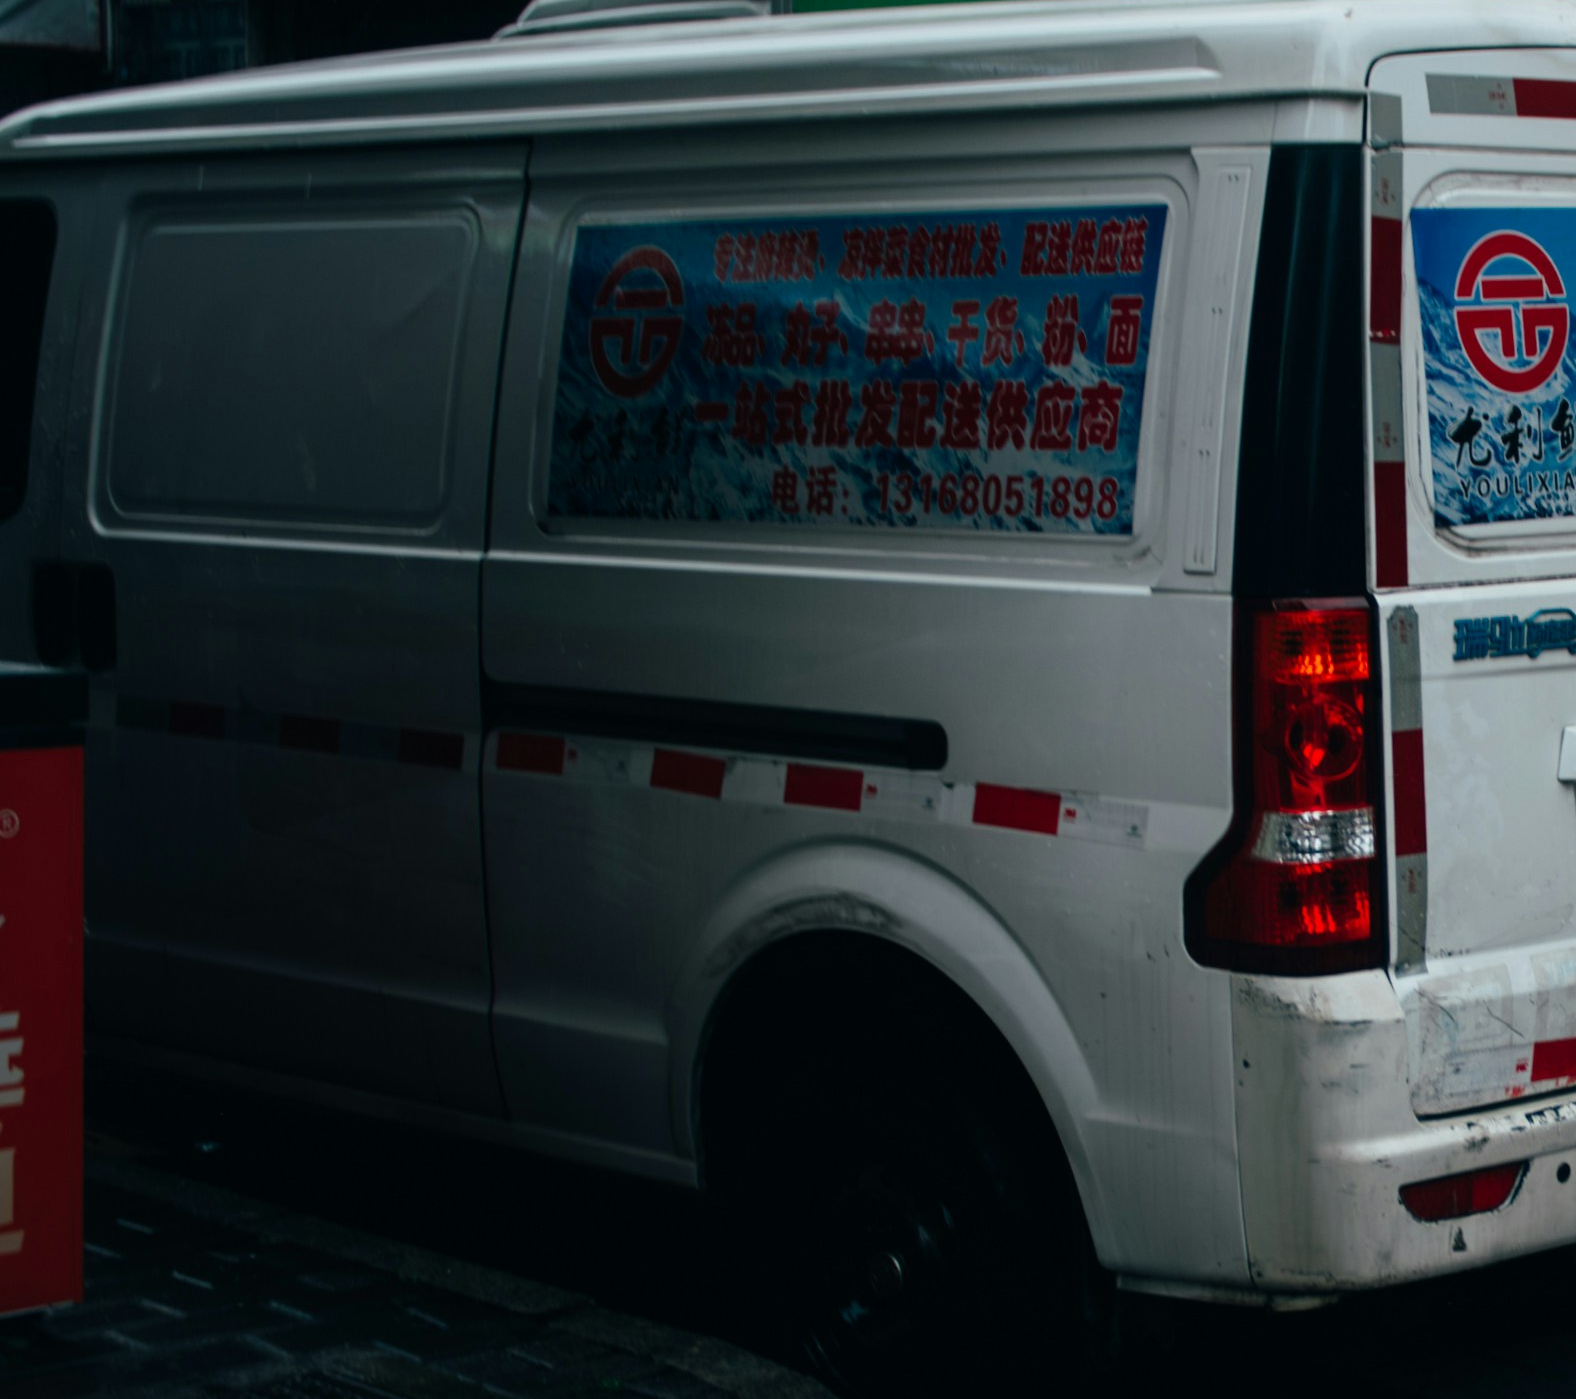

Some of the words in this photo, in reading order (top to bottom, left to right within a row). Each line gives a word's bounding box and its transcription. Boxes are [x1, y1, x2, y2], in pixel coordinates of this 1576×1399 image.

[694, 378, 1126, 452] 一站式批发配送供应商
[876, 472, 1120, 520] 13168051898
